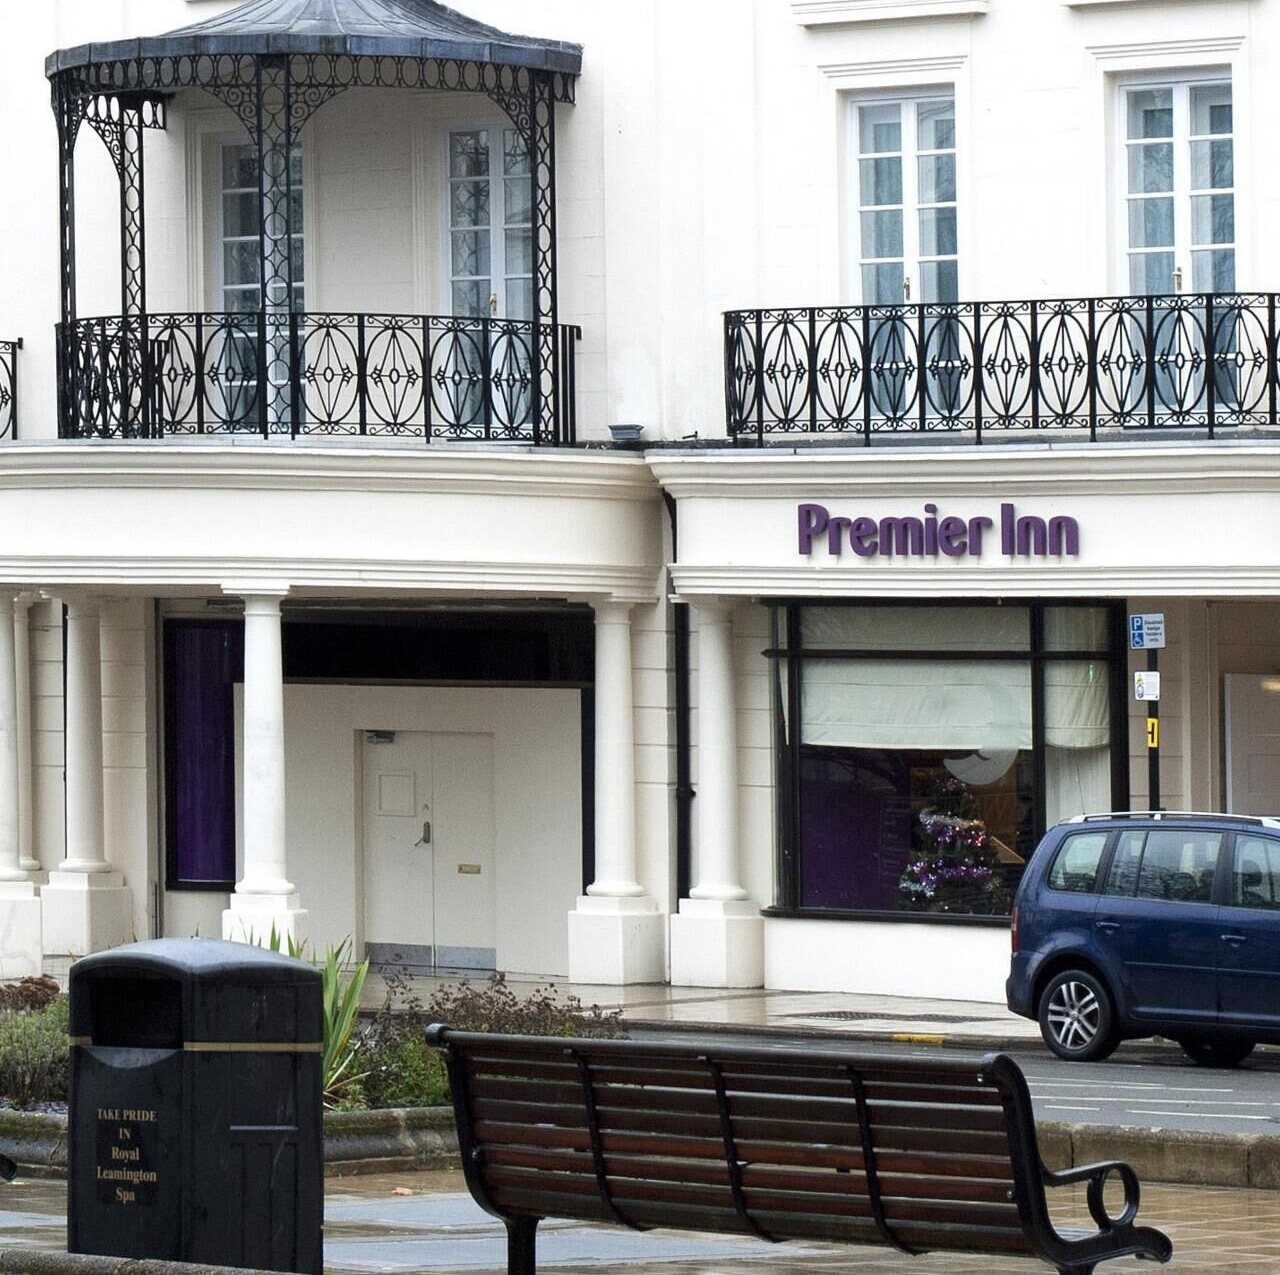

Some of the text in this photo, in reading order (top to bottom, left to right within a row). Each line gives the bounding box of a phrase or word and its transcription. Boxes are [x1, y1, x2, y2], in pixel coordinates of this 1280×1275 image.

[798, 503, 1080, 557] Premier Inn
[1133, 618, 1141, 630] P
[97, 1108, 157, 1122] TAKE PRIDE
[119, 1127, 131, 1140] IN
[112, 1146, 140, 1163] Royal
[97, 1166, 157, 1184] Leamington
[116, 1187, 135, 1205] Spa
